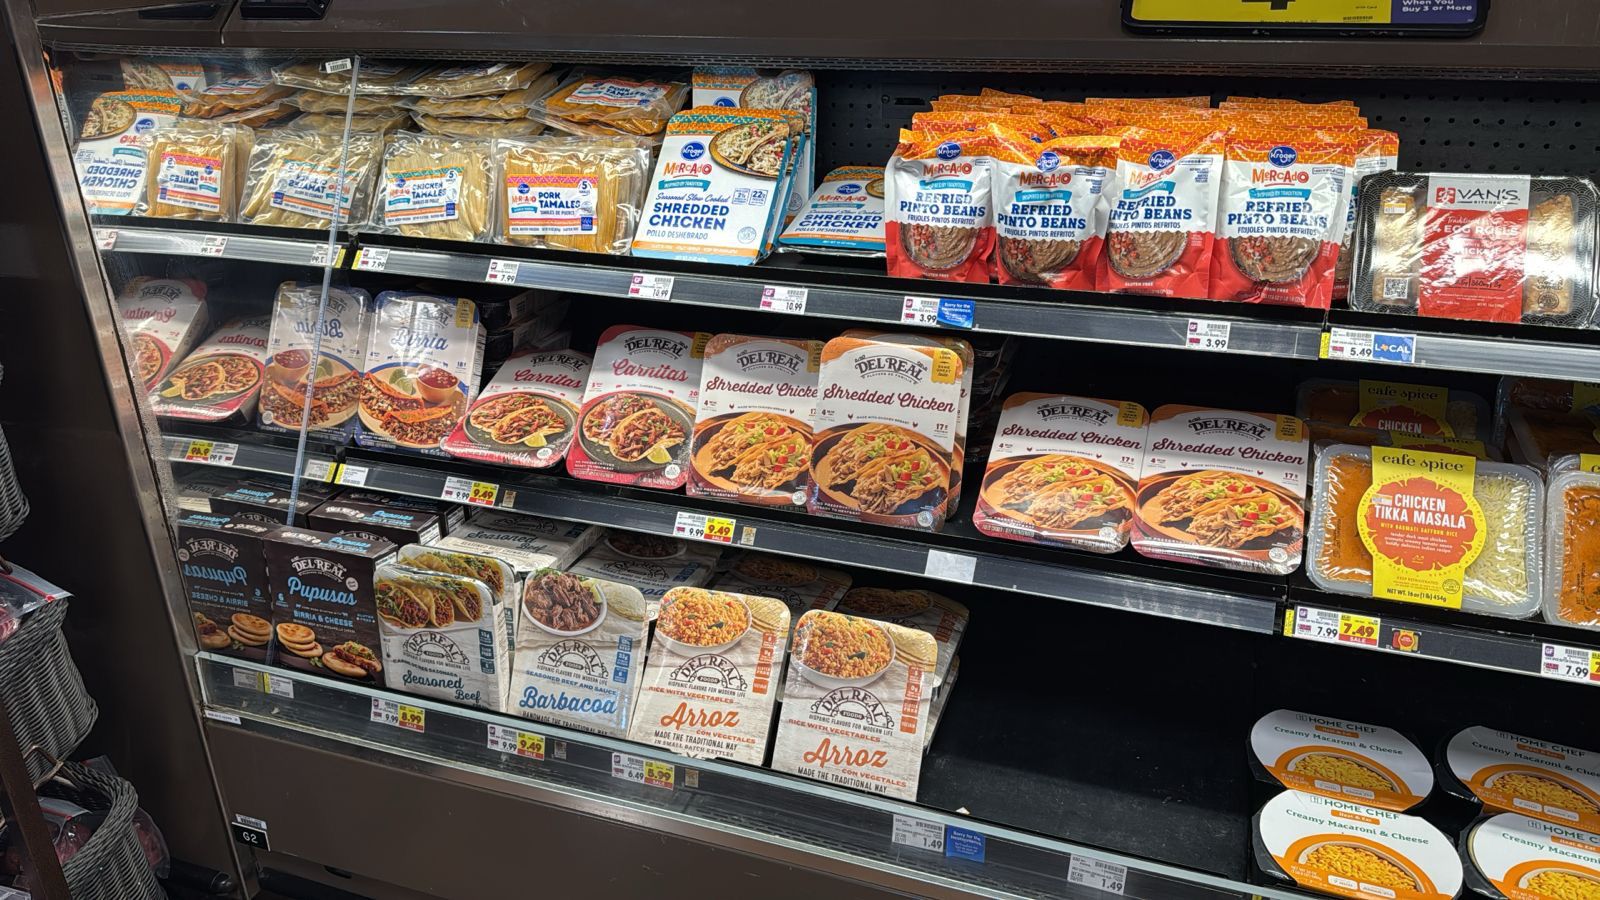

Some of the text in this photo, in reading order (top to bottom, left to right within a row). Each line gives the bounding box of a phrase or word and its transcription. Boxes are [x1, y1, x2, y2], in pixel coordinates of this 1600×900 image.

[682, 145, 704, 157] Kroger
[1270, 148, 1296, 163] Kroger
[412, 182, 444, 190] CHICKEN
[582, 180, 588, 190] 5
[538, 192, 560, 200] PORK
[656, 192, 685, 202] Seasoned
[686, 192, 704, 202] Slow
[705, 194, 731, 202] Cooked
[916, 191, 973, 205] REFRIED
[1458, 187, 1520, 200] VAN'S
[538, 200, 580, 209] TAMALES
[653, 203, 730, 216] SHREDDED
[900, 200, 986, 217] PINTO BEANS
[1011, 204, 1072, 216] REFRIED
[1117, 196, 1176, 211] REFRIED
[1246, 201, 1313, 213] REFRIED
[649, 214, 726, 230] CHICKEN
[804, 214, 882, 222] SHREDDED
[908, 214, 930, 222] FRIJOLES
[932, 216, 950, 224] PINTOS
[998, 213, 1086, 230] PINTO BEANS
[1108, 208, 1192, 222] INTO BEANS
[1228, 214, 1328, 228] PINTO BEANS
[798, 220, 878, 229] CHICKEN
[1266, 226, 1288, 234] PINTOS
[1290, 227, 1317, 236] REFRITOS
[646, 229, 708, 240] POLLO DESHEBRADO
[1004, 228, 1027, 236] FRIJOLES
[1050, 230, 1076, 238] REFRITOS
[372, 262, 385, 270] 7.99
[500, 274, 515, 283] 7.99
[786, 302, 803, 312] 10.99
[919, 314, 937, 323] 3.99
[391, 328, 448, 351] Birria
[1206, 338, 1227, 349] 3.99
[1350, 347, 1372, 357] 5.49
[612, 358, 689, 383] Carnitas
[855, 357, 924, 382] DEL REAL
[514, 369, 582, 390] Carnitas
[706, 376, 818, 398] Shredded Chicke
[1368, 384, 1438, 401] cafe spice
[822, 384, 956, 413] Shredded Chicken
[1037, 406, 1108, 426] DEL REAL
[1188, 420, 1266, 441] DEL REAL
[1378, 419, 1422, 434] CHICKEN
[1002, 424, 1142, 450] Shredded Chicken
[1152, 438, 1304, 466] Shredded Chicken
[1382, 454, 1464, 472] cafe spice
[456, 491, 470, 500] 9.99
[473, 490, 494, 500] 9.49
[1394, 493, 1446, 513] CHICKEN
[1374, 504, 1467, 529] TIKKA MASALA
[688, 528, 704, 538] 9.99
[708, 526, 730, 536] 9.49
[1395, 524, 1419, 532] BASMATI
[1420, 528, 1444, 536] SAFFRON
[1446, 530, 1458, 538] RICE
[465, 530, 540, 547] Seasoned
[292, 560, 346, 580] DEL REAL
[288, 576, 358, 606] Pupusas
[1316, 626, 1338, 638] 7.99
[1343, 622, 1375, 638] 7.49
[1566, 664, 1589, 678] 7.99
[402, 670, 464, 689] Seasoned
[526, 670, 618, 696] SEASONED BEEF AND SAUCE
[454, 689, 482, 704] Beef
[519, 686, 617, 714] Barbacoa
[648, 686, 734, 704] RICE WITH VEGETABLES
[386, 713, 399, 724] 9.99
[400, 712, 422, 724] 8.99
[660, 702, 740, 731] Arroz
[788, 718, 881, 742] RICE WITH VEGETABLES
[830, 718, 852, 728] FLAVORS
[852, 722, 862, 730] FOR
[862, 724, 882, 734] MODERN
[1308, 716, 1377, 734] HOME CHEF
[654, 730, 738, 751] MADE THE TRADITIONAL WAY
[712, 732, 756, 744] VEGETALES
[502, 742, 518, 752] 9.99
[520, 740, 542, 752] 9.49
[803, 738, 888, 768] Arroz
[1510, 735, 1586, 757] HOME CHEF
[628, 770, 644, 781] 6.49
[646, 768, 671, 782] 5.99
[798, 766, 888, 794] MADE THE TRADITIONAL WAY
[841, 768, 906, 788] CON VEGETALES
[1324, 798, 1400, 820] HOME CHEF
[1286, 808, 1429, 845] Creamy Macaroni & Cheese
[1544, 824, 1584, 840] HOME
[242, 832, 258, 844] G2
[922, 837, 942, 850] 1.49
[1100, 878, 1122, 892] 1.49
